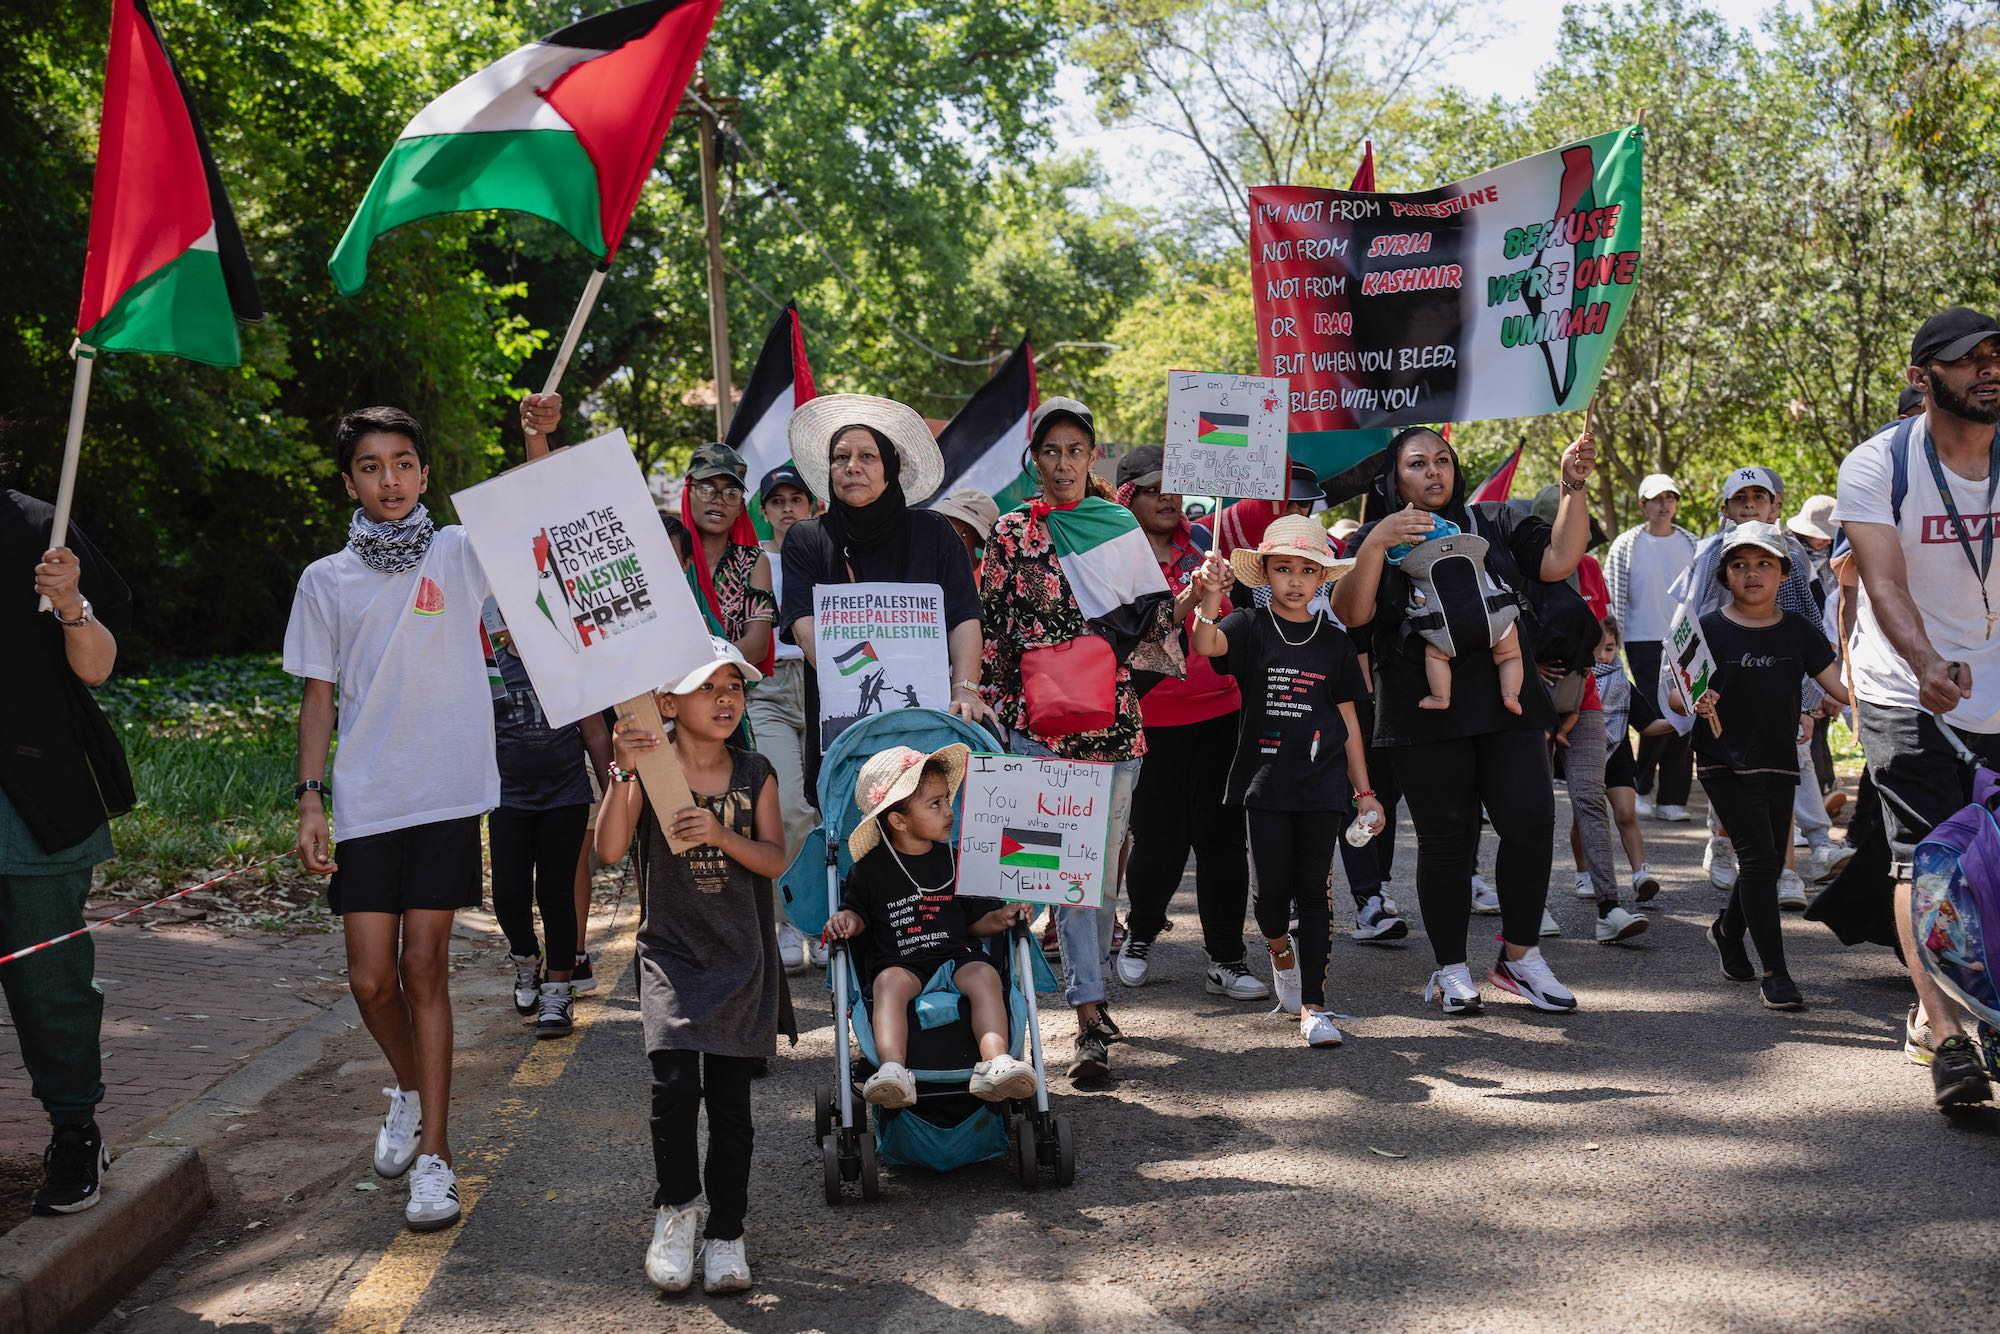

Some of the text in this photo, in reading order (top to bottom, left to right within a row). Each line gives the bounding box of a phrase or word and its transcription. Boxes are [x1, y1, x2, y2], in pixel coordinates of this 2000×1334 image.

[1258, 184, 1499, 225] I'M NOT FROM PALESTINE
[1262, 231, 1432, 264] NOT FROM SYRIA
[1503, 204, 1622, 260] BECAUSE
[1266, 263, 1463, 301] NOT FROM KASHMIR
[1487, 250, 1641, 308] WE'RE ONE
[1270, 312, 1353, 338] OR IRAQ
[1500, 301, 1610, 349] UMMAH
[1273, 344, 1457, 377] BUT WHEN YOU BLEED,
[1179, 374, 1199, 391] I
[1207, 382, 1222, 390] am
[1220, 392, 1229, 406] 8
[1289, 385, 1420, 413] BLEED WITH YOU
[1165, 458, 1196, 478] the
[1261, 462, 1277, 479] in
[1166, 443, 1269, 468] I cry 4 all
[550, 506, 617, 543] FROM THE
[555, 521, 626, 558] RIVER
[559, 536, 635, 575] TO THE SEA
[564, 553, 643, 599] PALESTINE
[572, 573, 649, 613] WILL BE
[573, 588, 658, 648] FREE
[1673, 616, 1692, 653] FREE
[1740, 652, 1776, 668] love
[974, 756, 1101, 788] I am Tayyibah
[983, 786, 1093, 817] You Killed
[974, 811, 1078, 831] many who are
[1059, 871, 1093, 881] ONLY
[1064, 880, 1085, 904] 3
[900, 916, 915, 926] FROM
